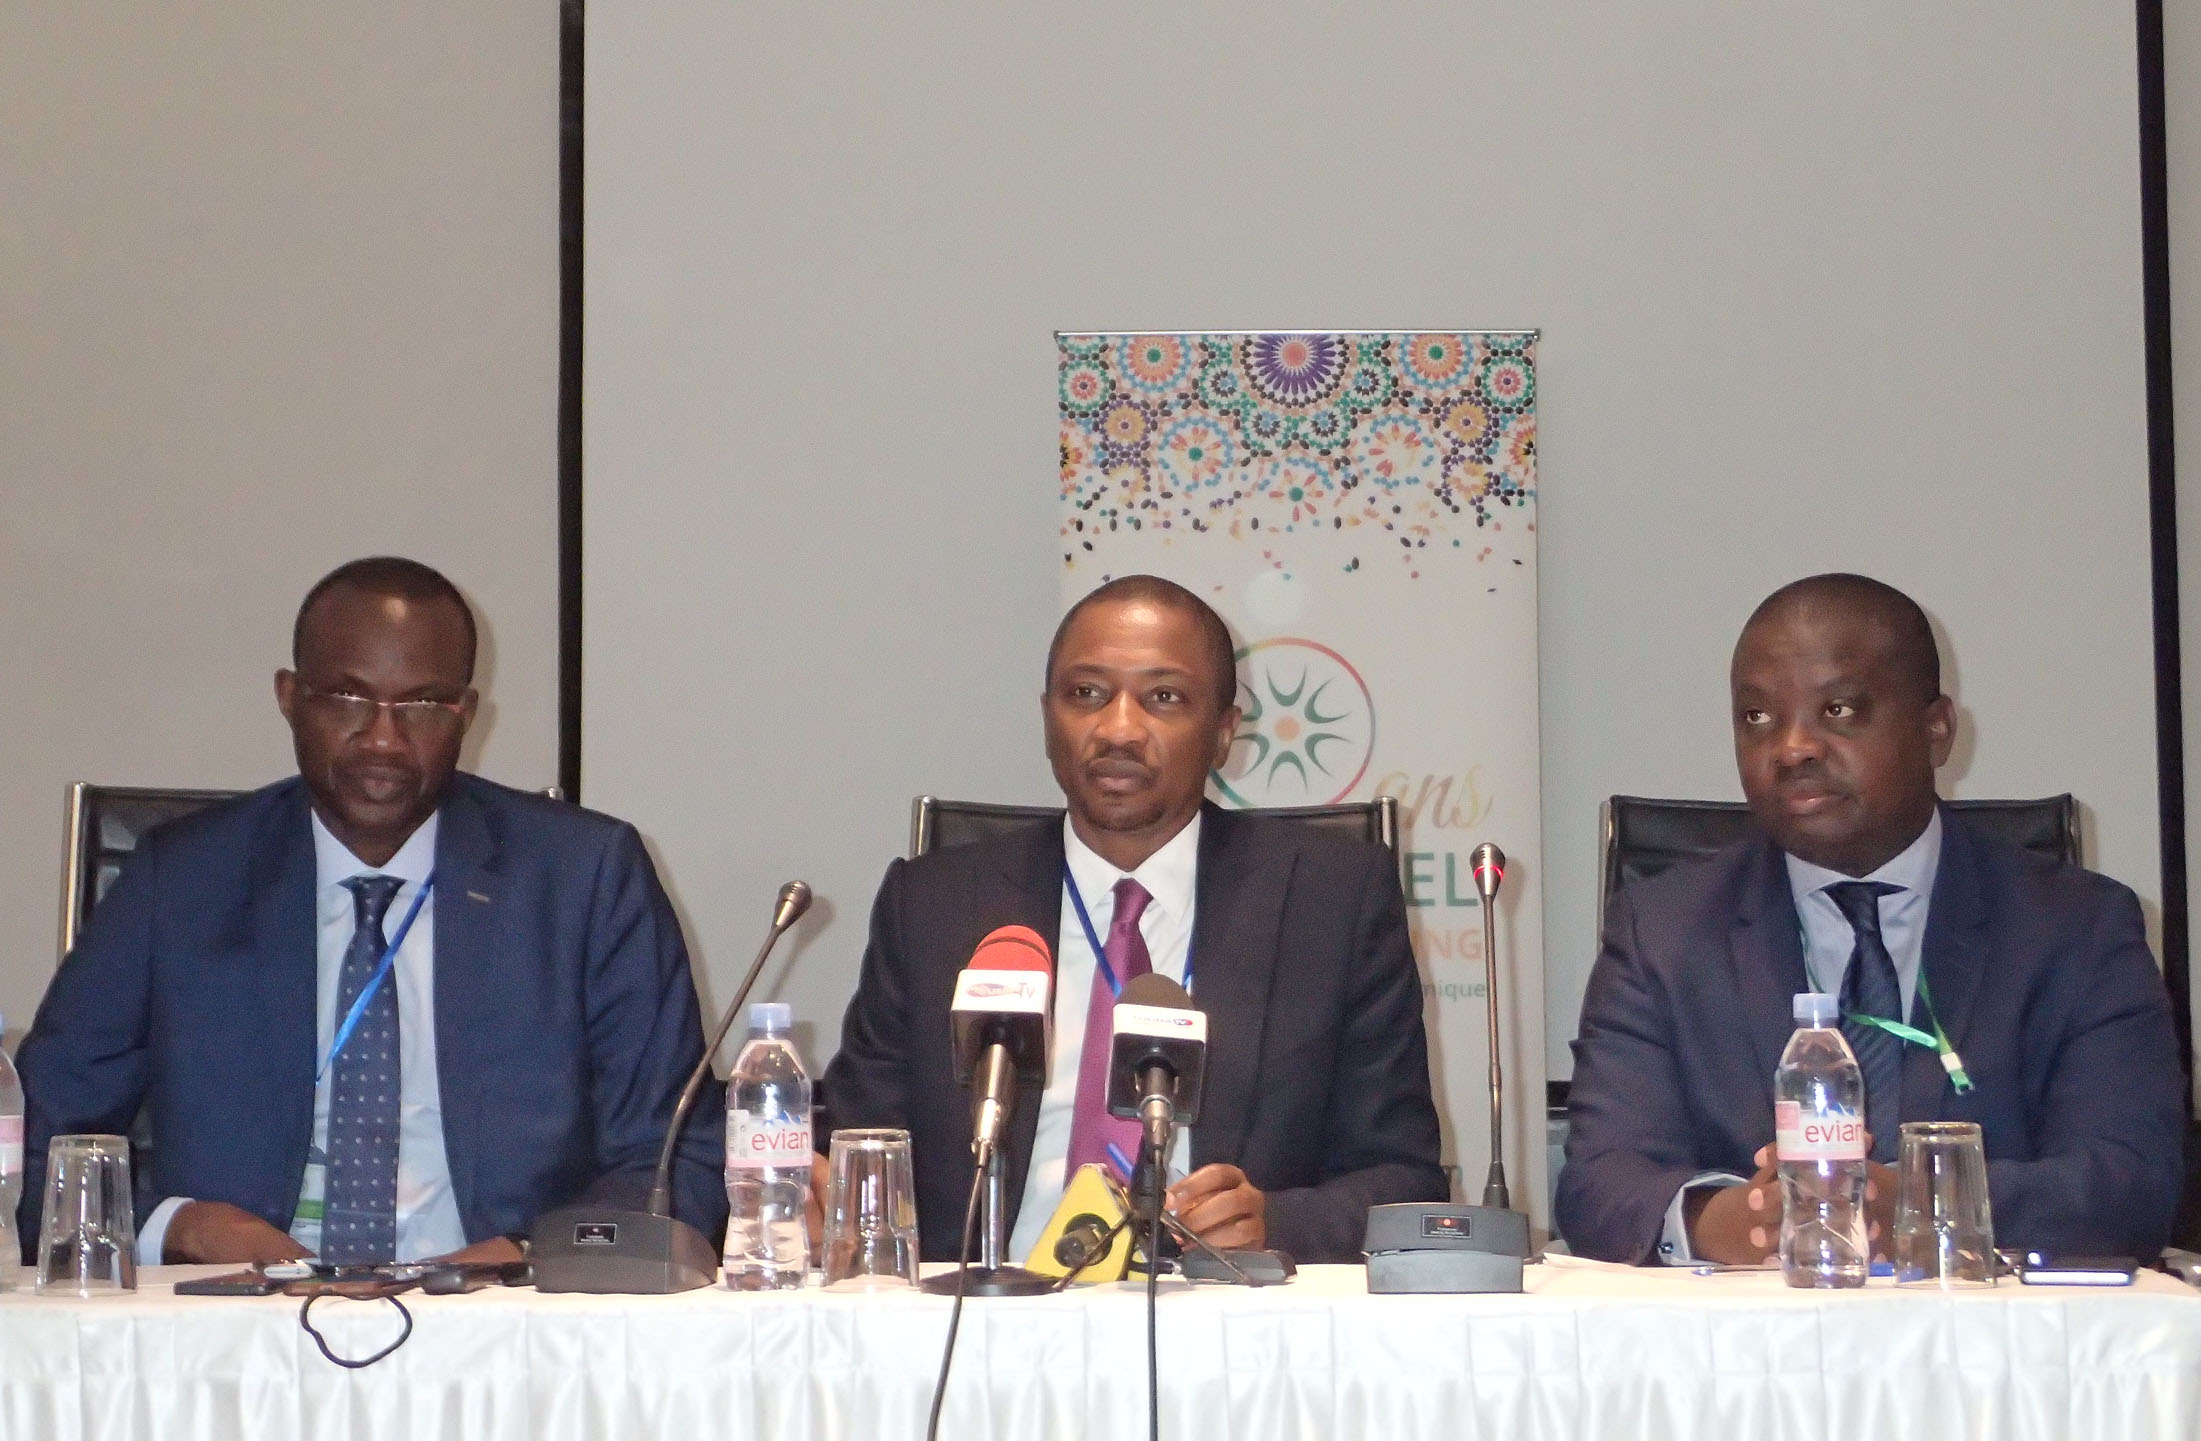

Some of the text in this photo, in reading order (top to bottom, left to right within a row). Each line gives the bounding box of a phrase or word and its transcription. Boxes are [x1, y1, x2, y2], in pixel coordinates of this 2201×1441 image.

[1403, 852, 1479, 908] EL
[751, 1128, 809, 1151] evian
[1805, 1121, 1862, 1143] evian
